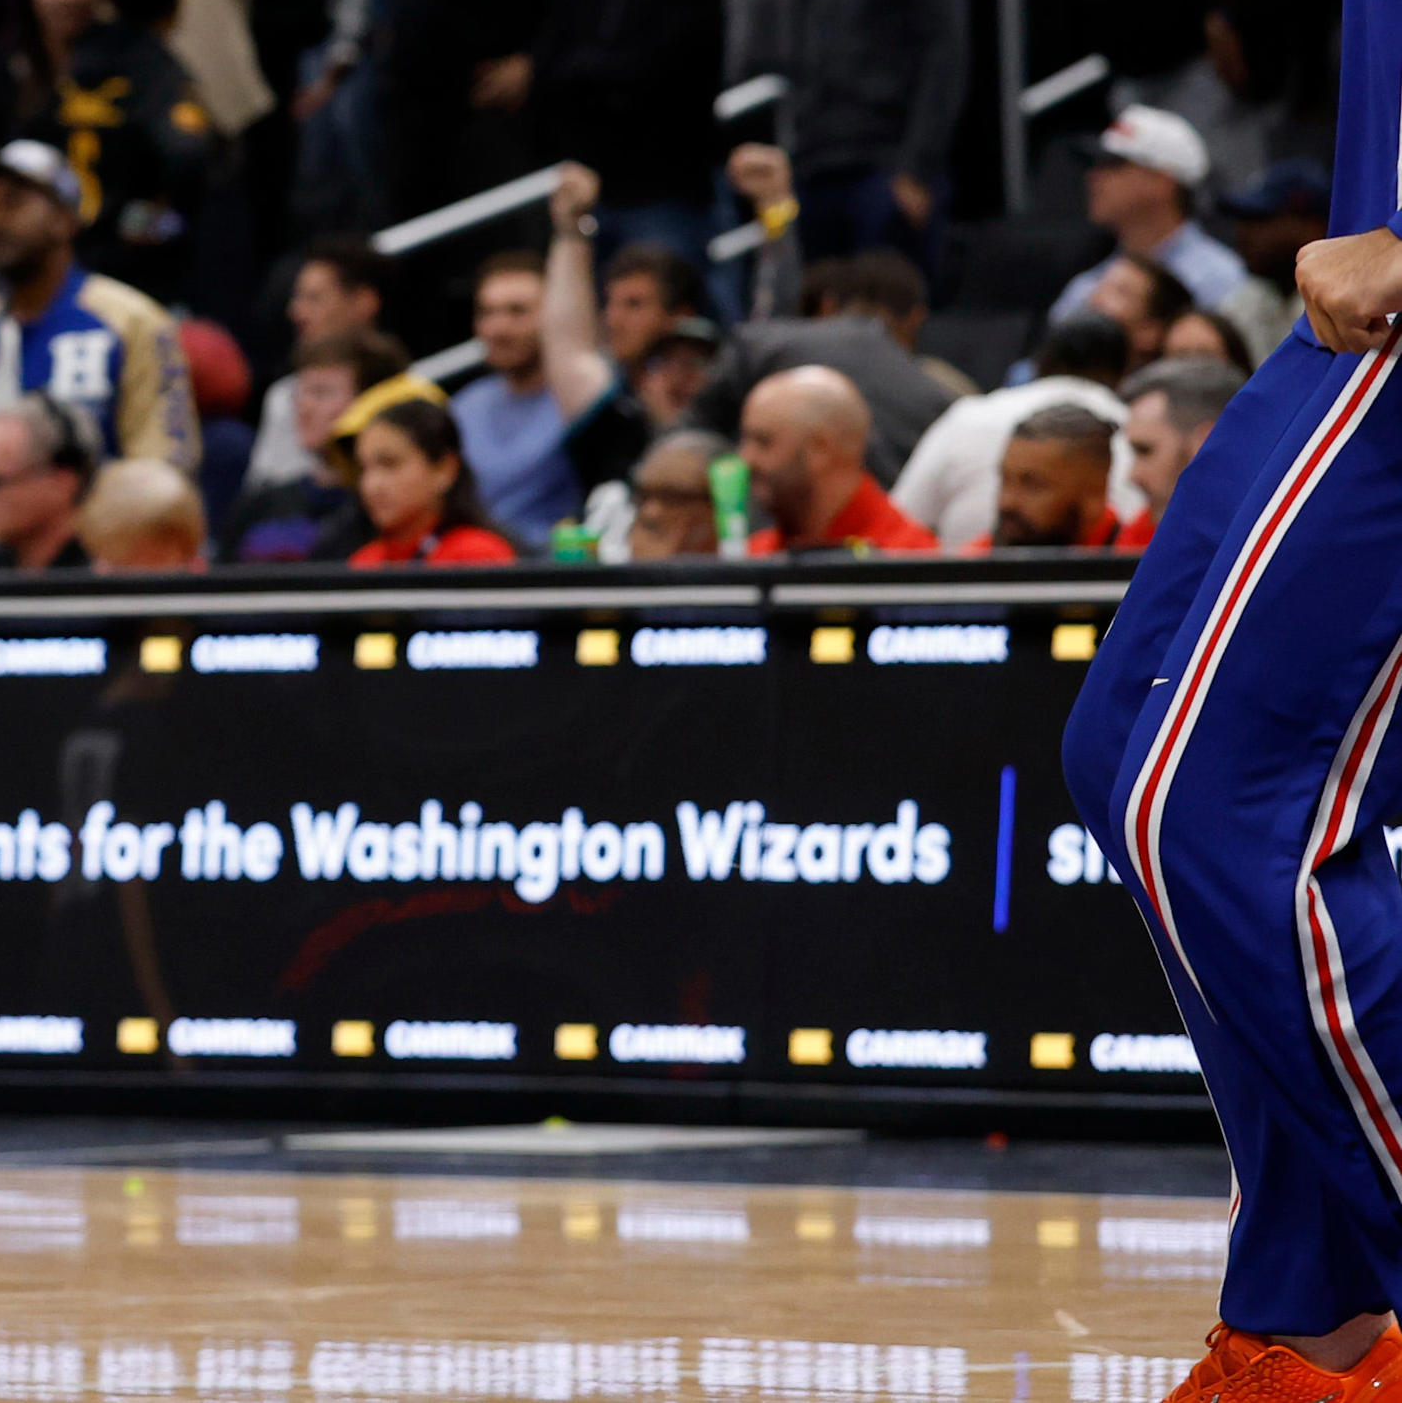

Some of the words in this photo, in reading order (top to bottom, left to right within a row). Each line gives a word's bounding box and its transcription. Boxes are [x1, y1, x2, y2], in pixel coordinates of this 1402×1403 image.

[76, 799, 176, 883] for
[178, 799, 284, 883] the
[290, 798, 666, 904] Washington
[675, 799, 952, 884] Wizards
